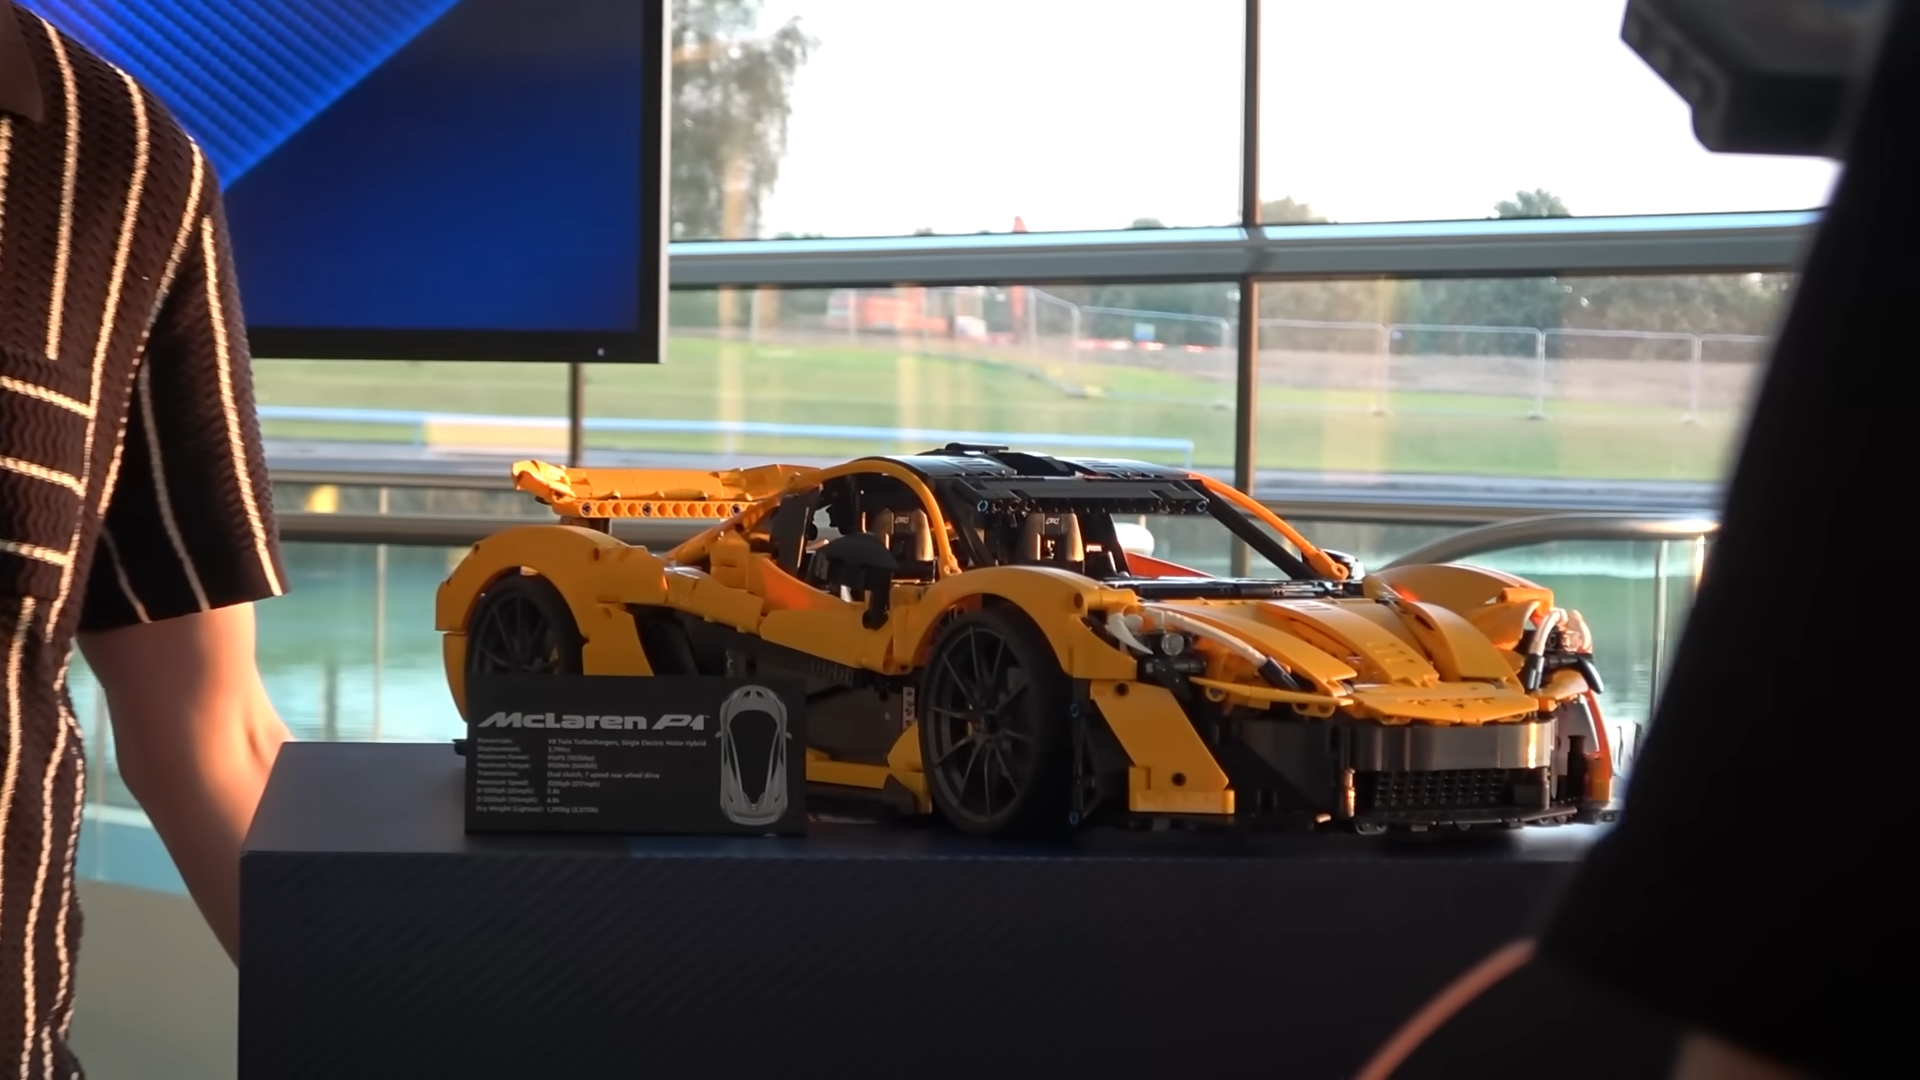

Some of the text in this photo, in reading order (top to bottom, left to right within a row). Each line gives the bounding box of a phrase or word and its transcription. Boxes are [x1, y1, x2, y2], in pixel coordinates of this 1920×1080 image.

[477, 712, 647, 729] McLaren
[621, 739, 640, 748] Single
[685, 739, 707, 748] Hybrid
[547, 770, 561, 778] Dual
[477, 805, 487, 813] Dry
[488, 805, 511, 813] Weight
